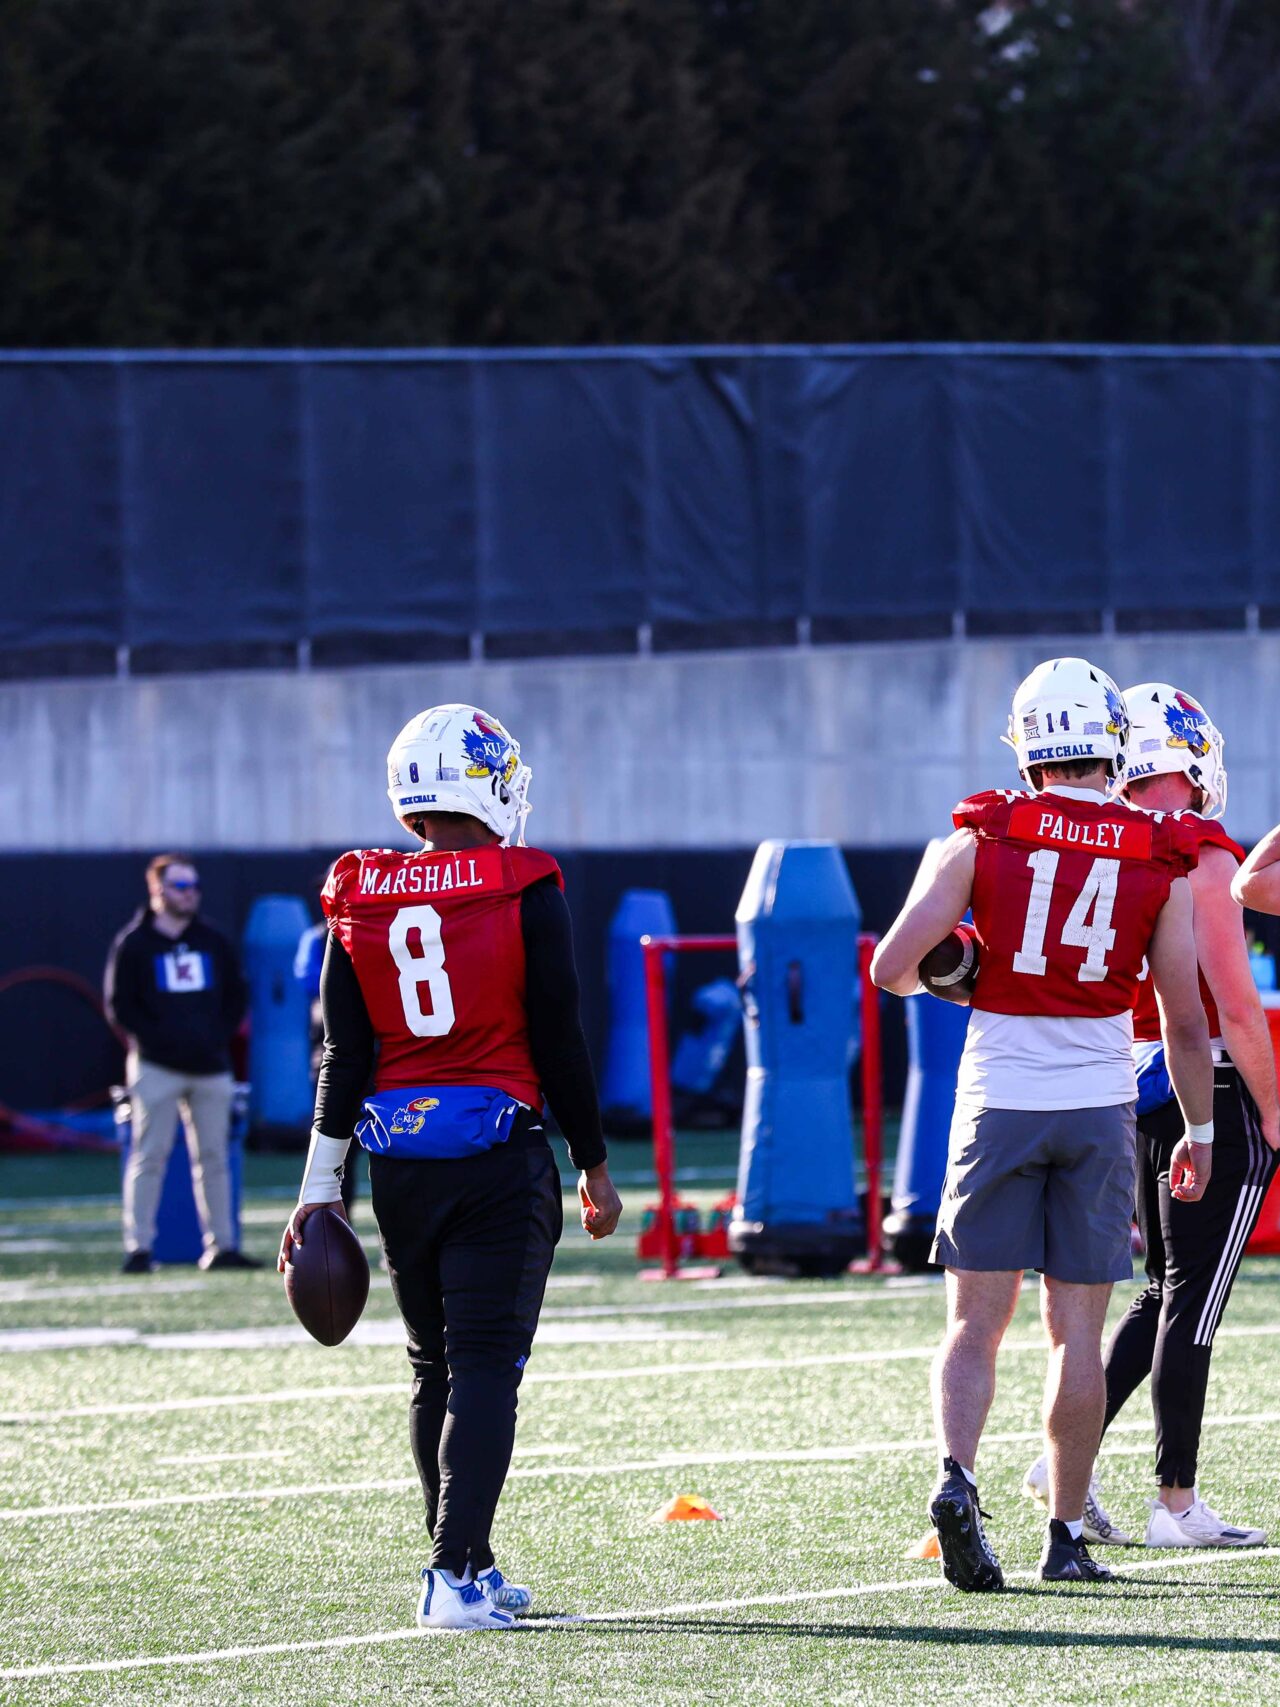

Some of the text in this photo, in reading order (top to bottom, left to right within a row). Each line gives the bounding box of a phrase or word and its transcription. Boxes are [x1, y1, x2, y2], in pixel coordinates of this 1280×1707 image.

[1046, 711, 1070, 733] 14
[1182, 717, 1198, 731] KU
[483, 742, 501, 758] KU
[1055, 744, 1094, 758] CHALK
[409, 762, 419, 783] 8
[1037, 813, 1125, 849] PAULEY
[361, 859, 483, 894] MARSHALL
[1012, 848, 1121, 982] 14
[388, 904, 456, 1038] 8
[403, 1114, 414, 1123] KU
